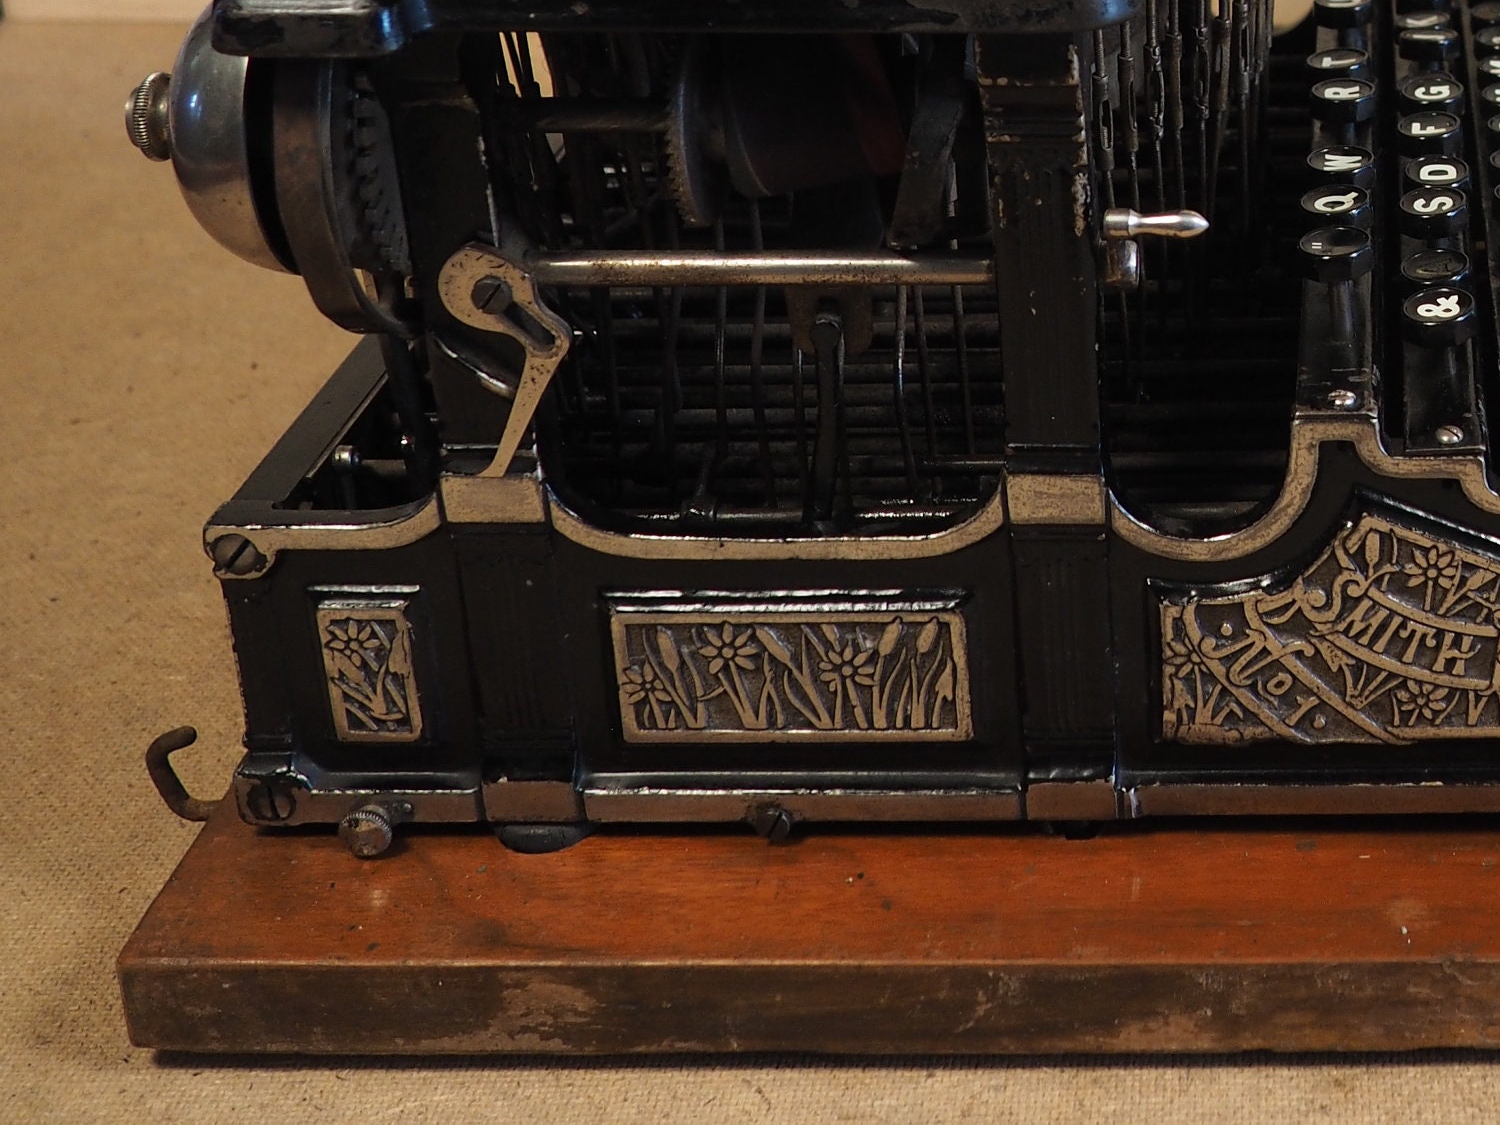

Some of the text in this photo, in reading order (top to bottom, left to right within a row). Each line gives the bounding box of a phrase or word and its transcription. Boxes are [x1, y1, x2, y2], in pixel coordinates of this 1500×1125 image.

[1324, 85, 1360, 100] R
[1414, 84, 1450, 100] G
[1411, 122, 1447, 135] F
[1323, 153, 1362, 171] W
[1419, 163, 1457, 181] D
[1314, 191, 1359, 212] Q
[1413, 196, 1454, 213] S
[1416, 295, 1461, 318] &
